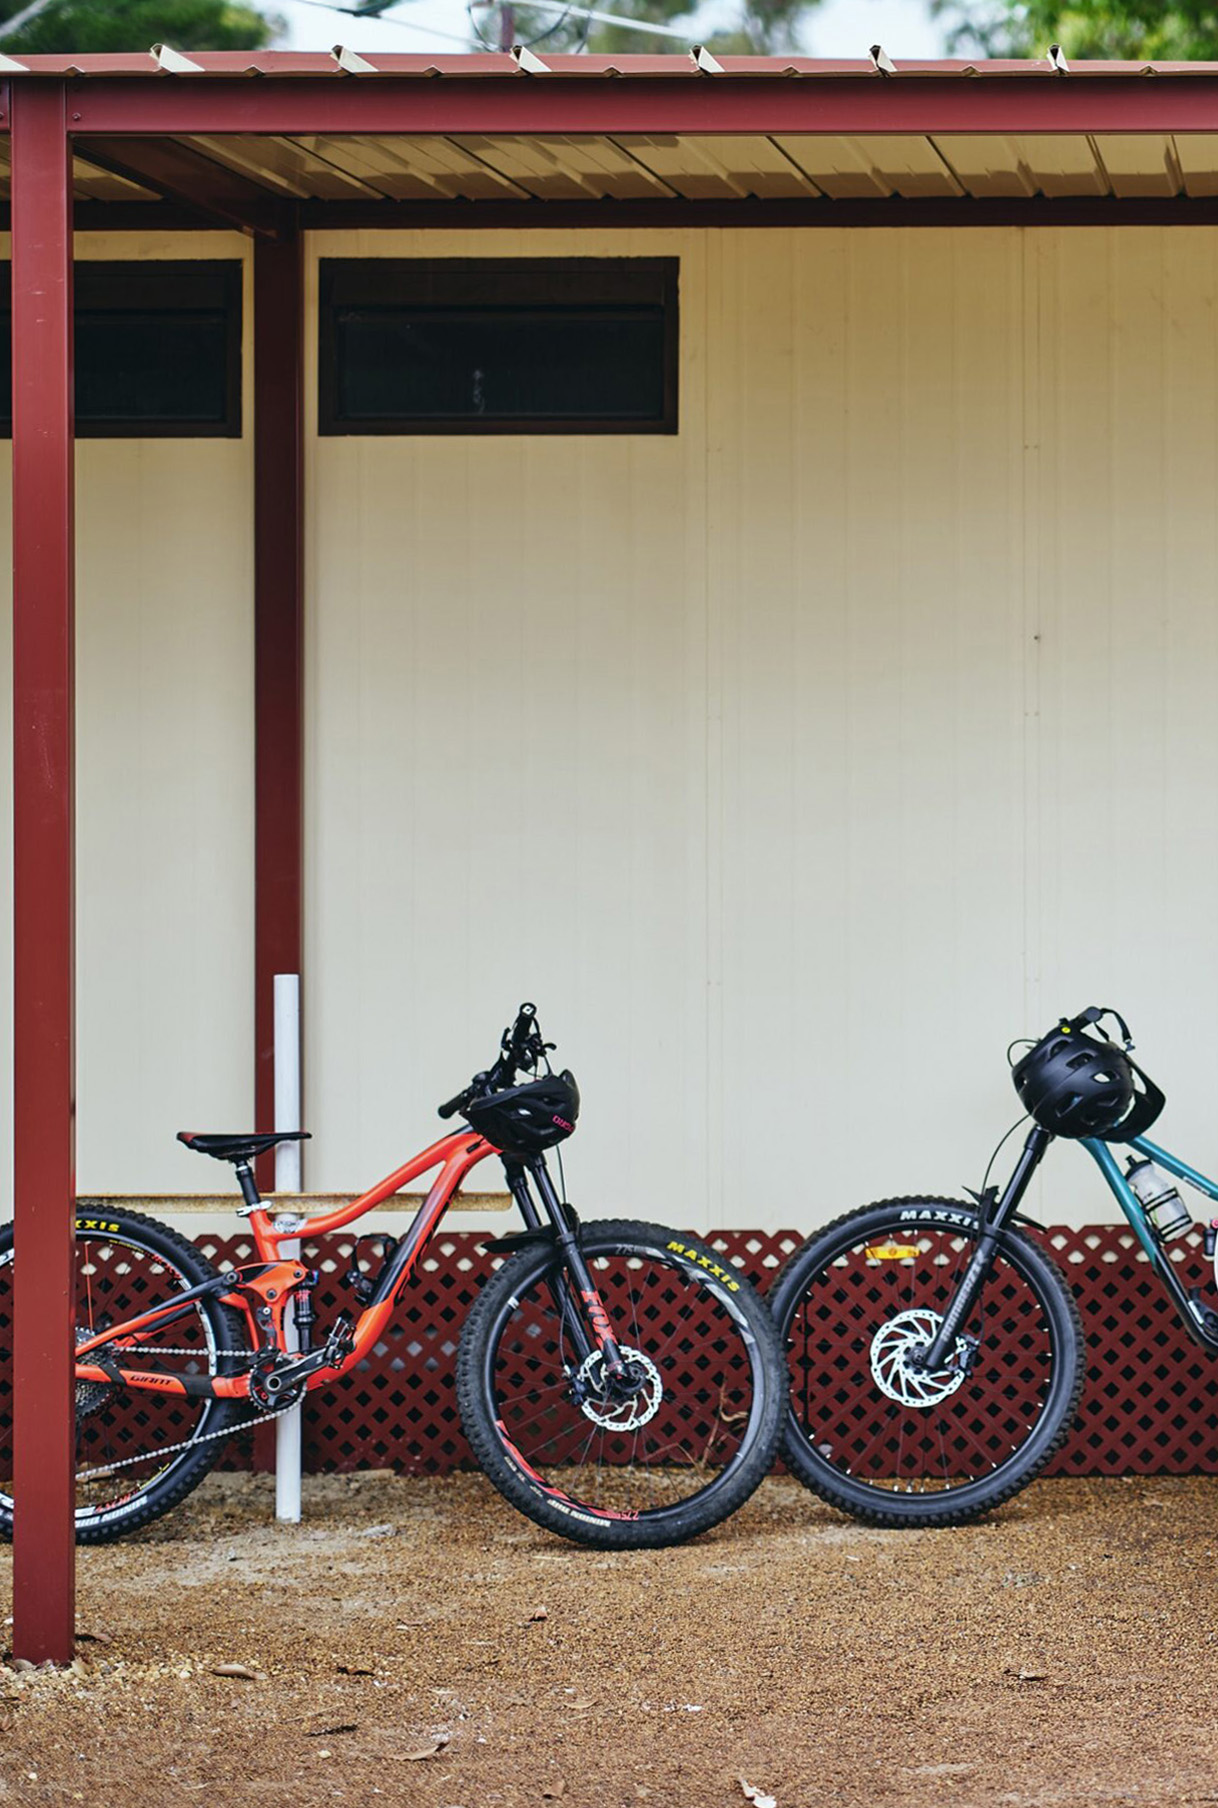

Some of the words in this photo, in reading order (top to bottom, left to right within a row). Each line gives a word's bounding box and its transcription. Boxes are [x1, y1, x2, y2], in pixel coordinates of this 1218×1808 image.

[75, 1219, 120, 1232] XXIS
[900, 1210, 980, 1230] MAXXIS
[666, 1240, 740, 1292] MAXXIS
[581, 1289, 619, 1352] FOX
[130, 1373, 171, 1386] GIANT
[570, 1510, 612, 1528] MINION
